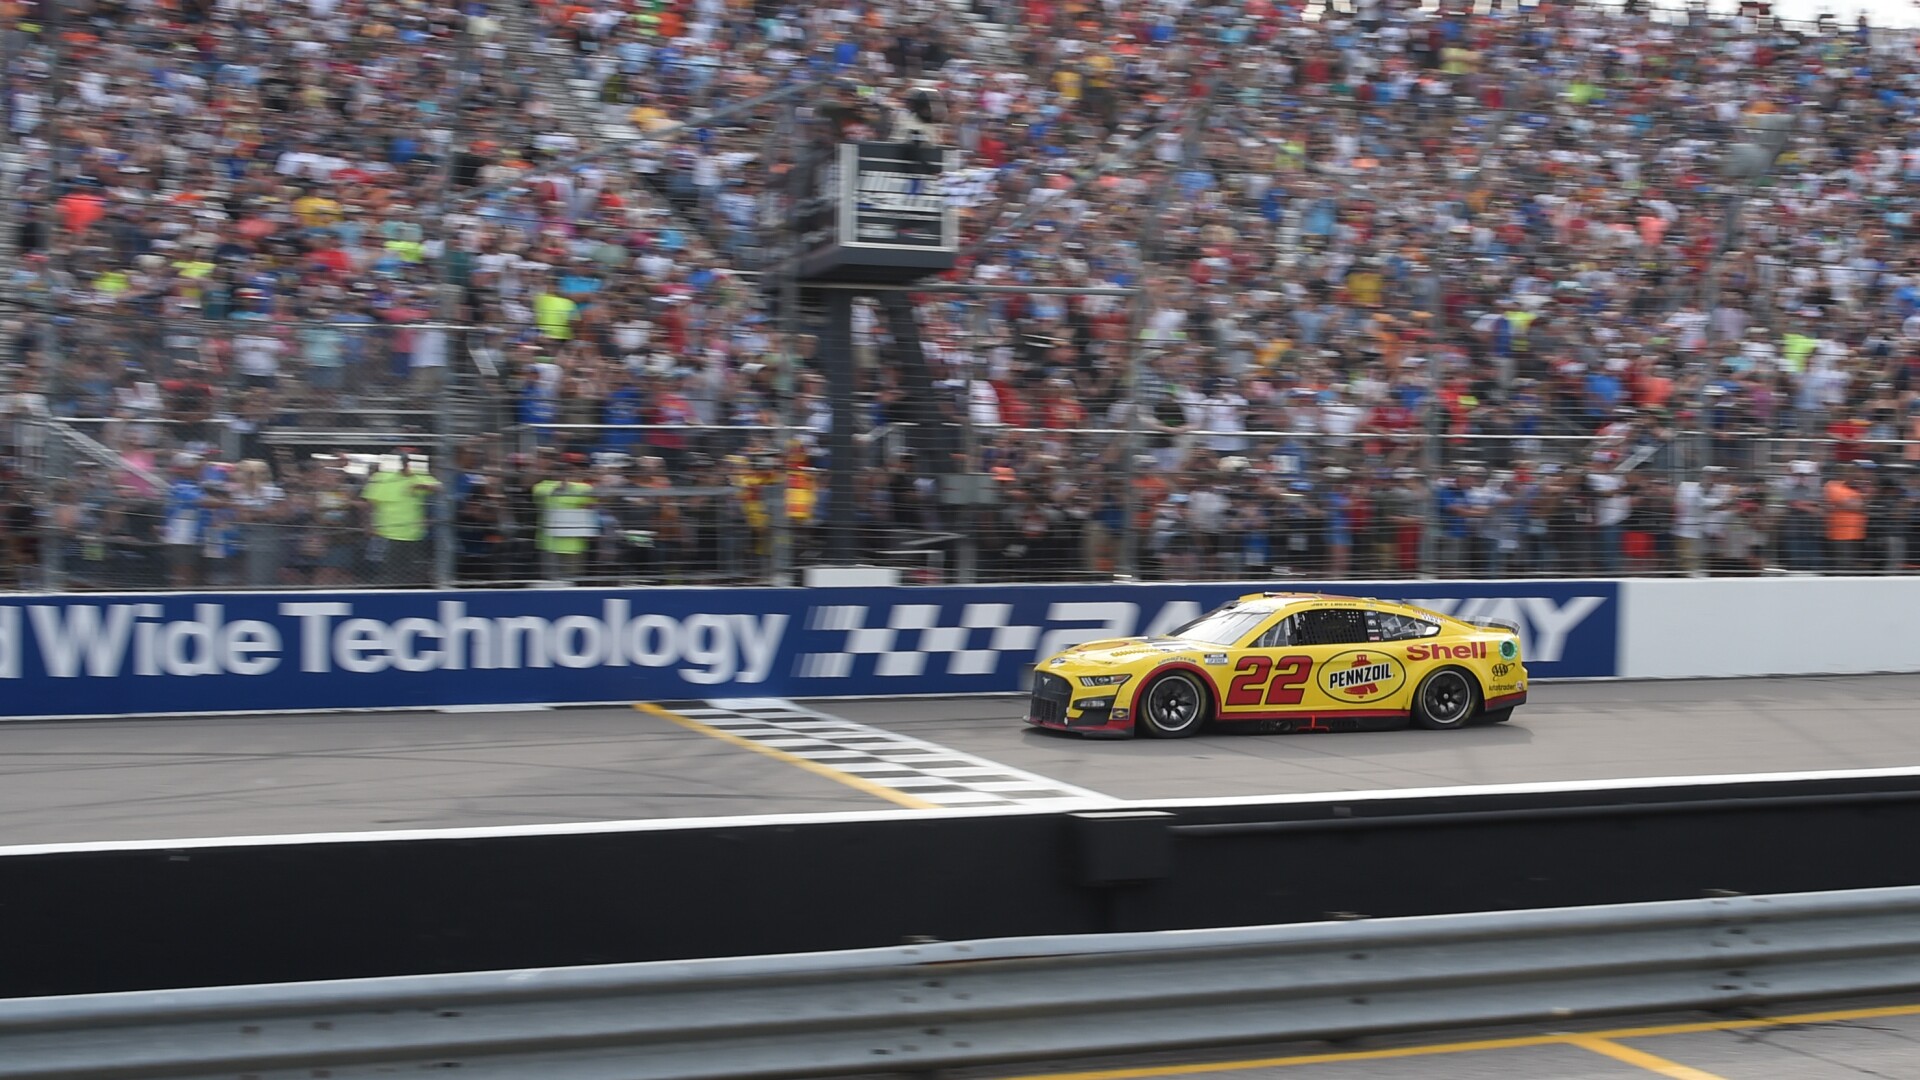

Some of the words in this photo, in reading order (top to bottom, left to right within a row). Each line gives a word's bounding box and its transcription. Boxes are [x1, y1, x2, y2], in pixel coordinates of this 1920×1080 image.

[26, 603, 283, 676] Wide
[278, 598, 791, 684] Technology
[1406, 641, 1486, 661] Shell
[1225, 655, 1314, 706] 22
[1328, 663, 1392, 689] PENNZOIL
